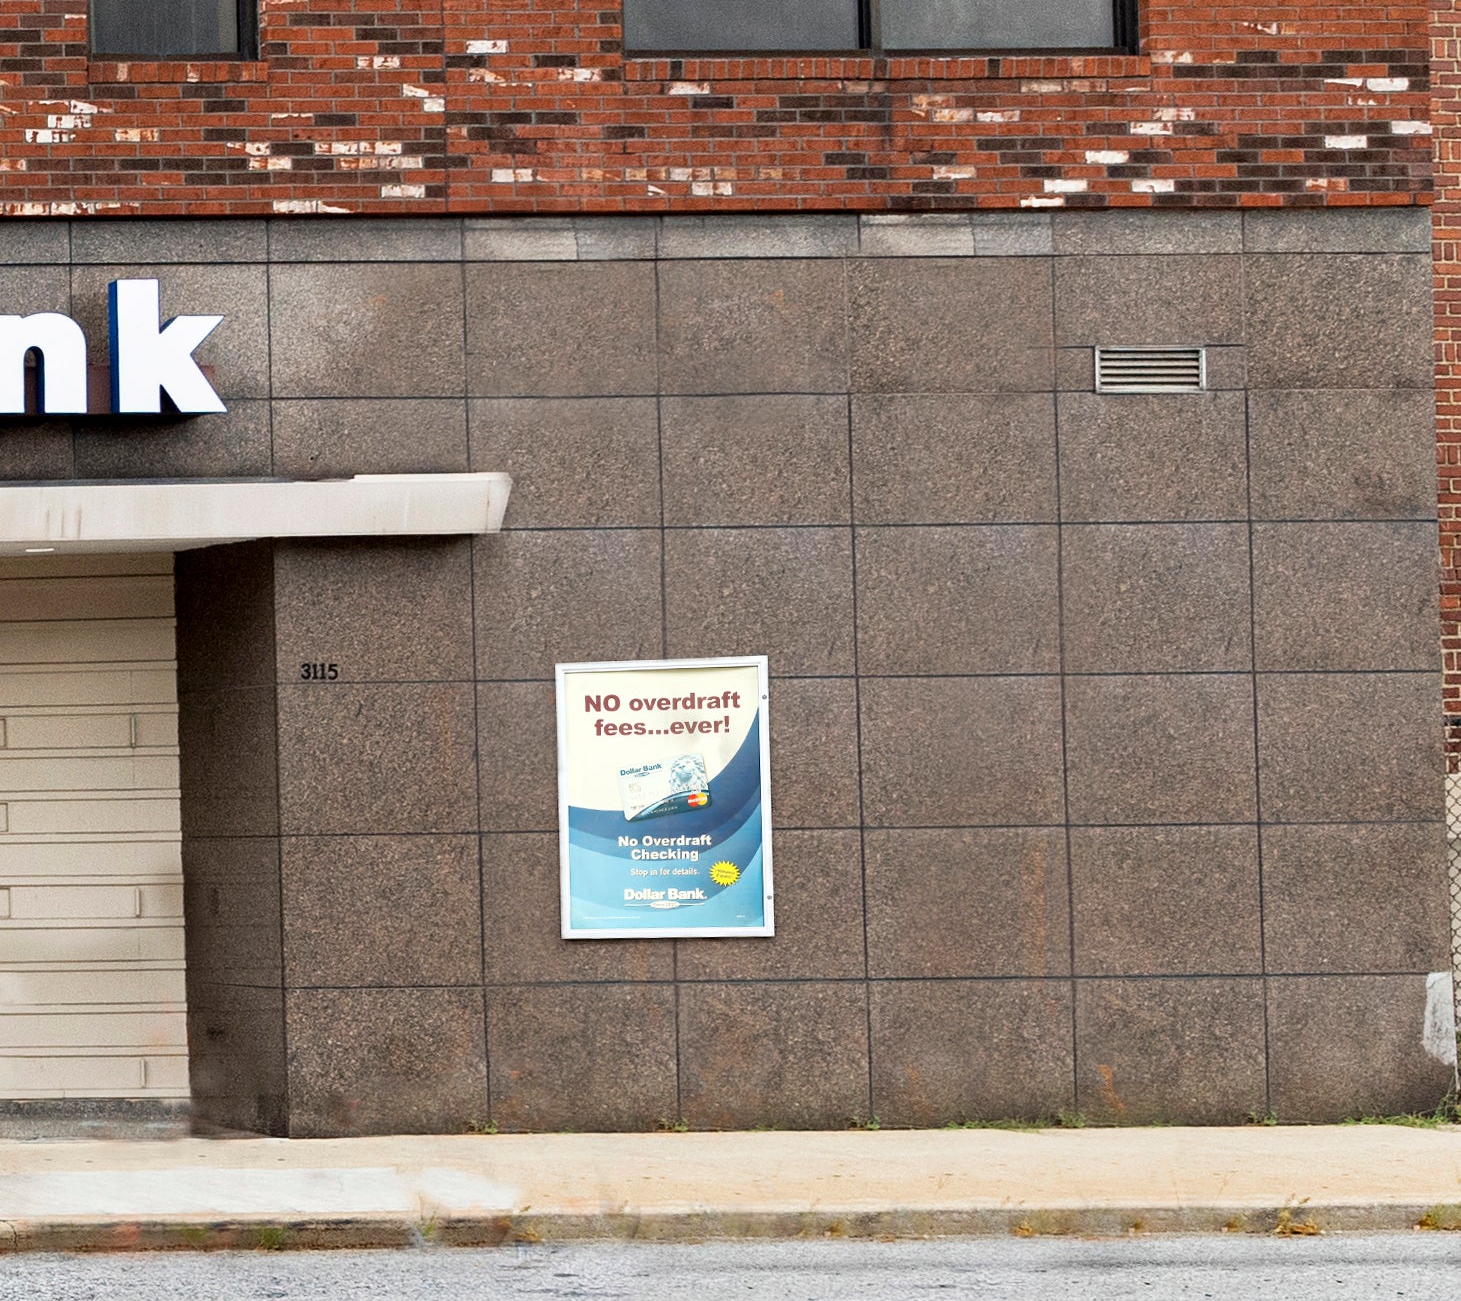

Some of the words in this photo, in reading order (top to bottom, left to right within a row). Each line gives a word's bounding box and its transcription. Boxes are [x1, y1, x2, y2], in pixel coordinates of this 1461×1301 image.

[301, 663, 338, 680] 3115
[584, 694, 621, 712] NO
[629, 691, 741, 711] overdraft
[619, 766, 642, 777] Dollar
[642, 763, 662, 772] Bank
[618, 835, 638, 847] No
[642, 834, 712, 847] Overdraft
[631, 848, 699, 862] Checking
[630, 868, 648, 877] Stop
[650, 867, 658, 876] in
[660, 867, 670, 876] for
[624, 888, 666, 901] Dollar
[667, 887, 705, 900] Bank
